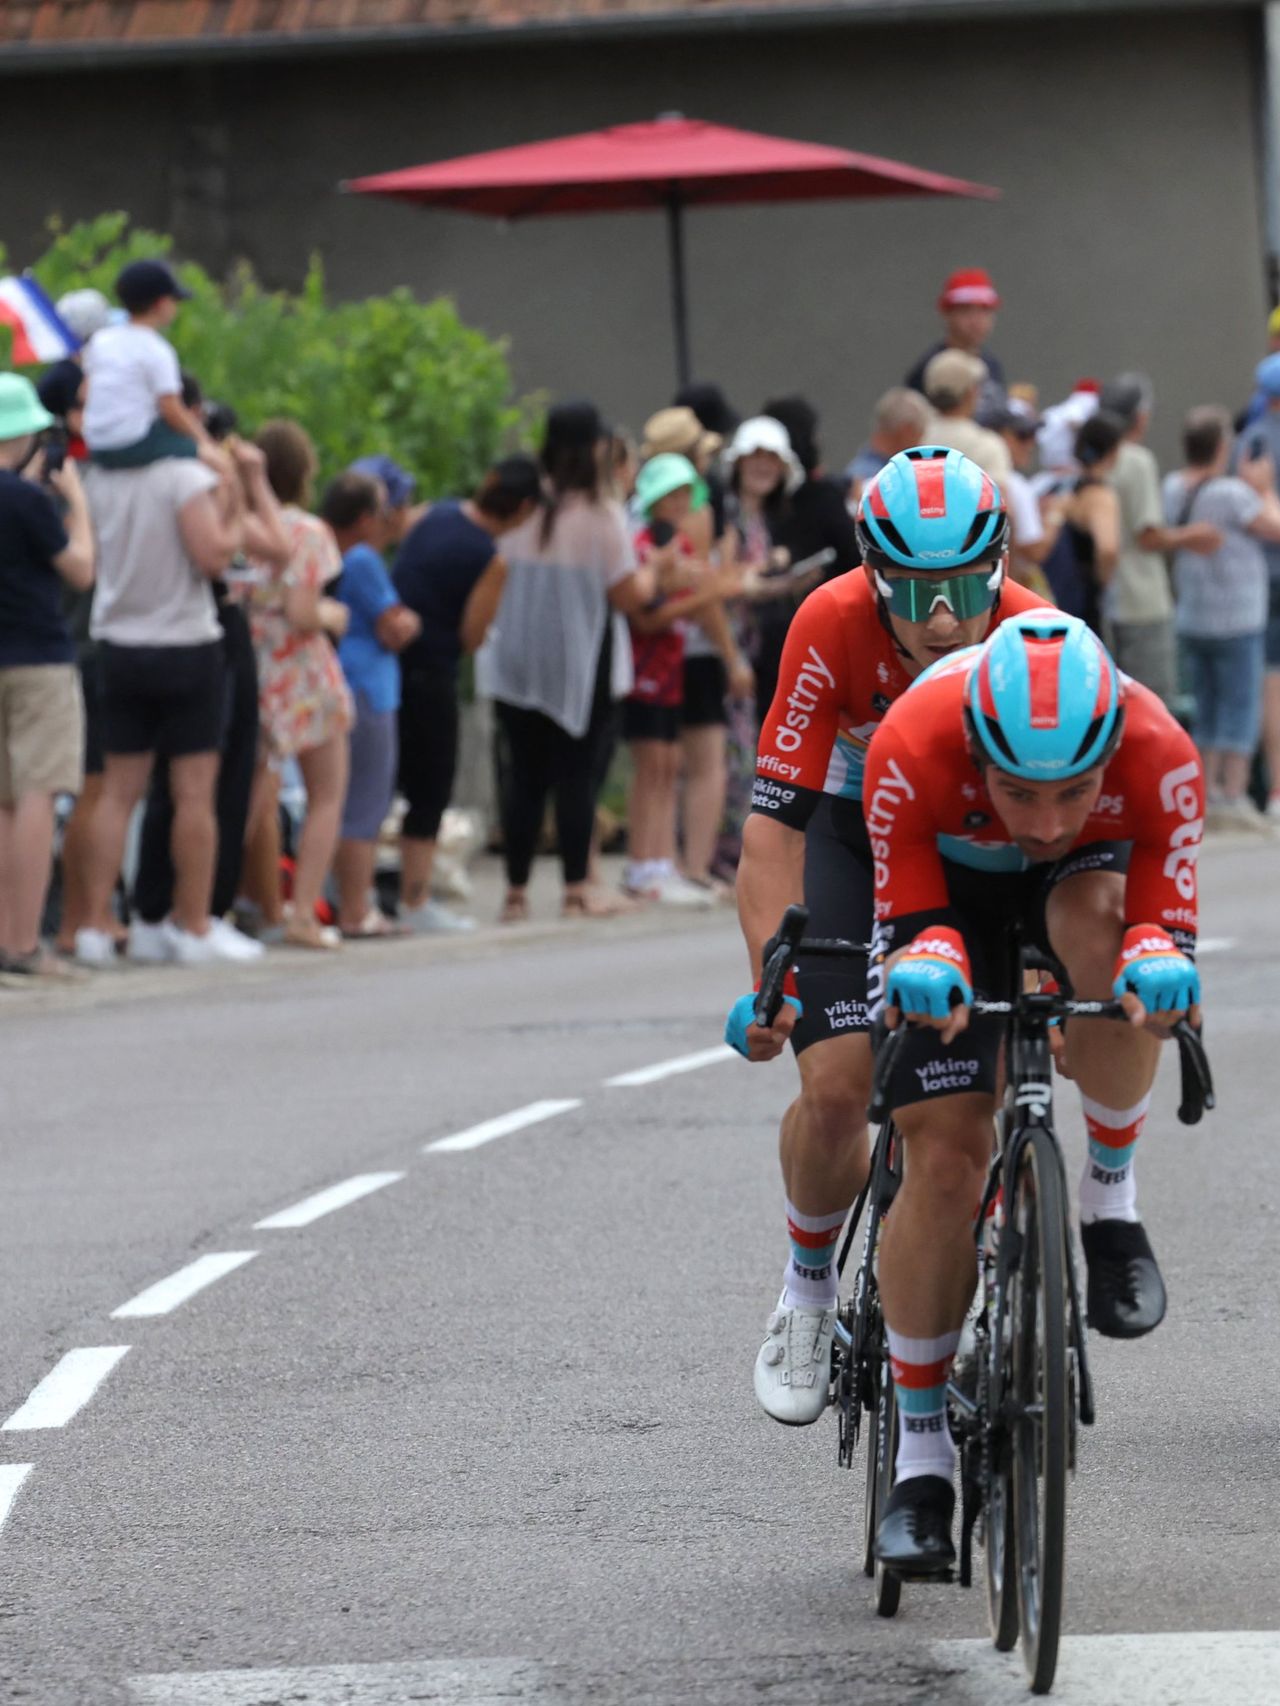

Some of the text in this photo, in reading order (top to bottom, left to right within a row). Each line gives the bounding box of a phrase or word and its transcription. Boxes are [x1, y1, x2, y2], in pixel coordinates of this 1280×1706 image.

[775, 645, 836, 752] dstny
[756, 754, 802, 780] efficy
[824, 1000, 870, 1017] vikin
[915, 1058, 980, 1080] viking
[921, 1074, 972, 1092] lotto
